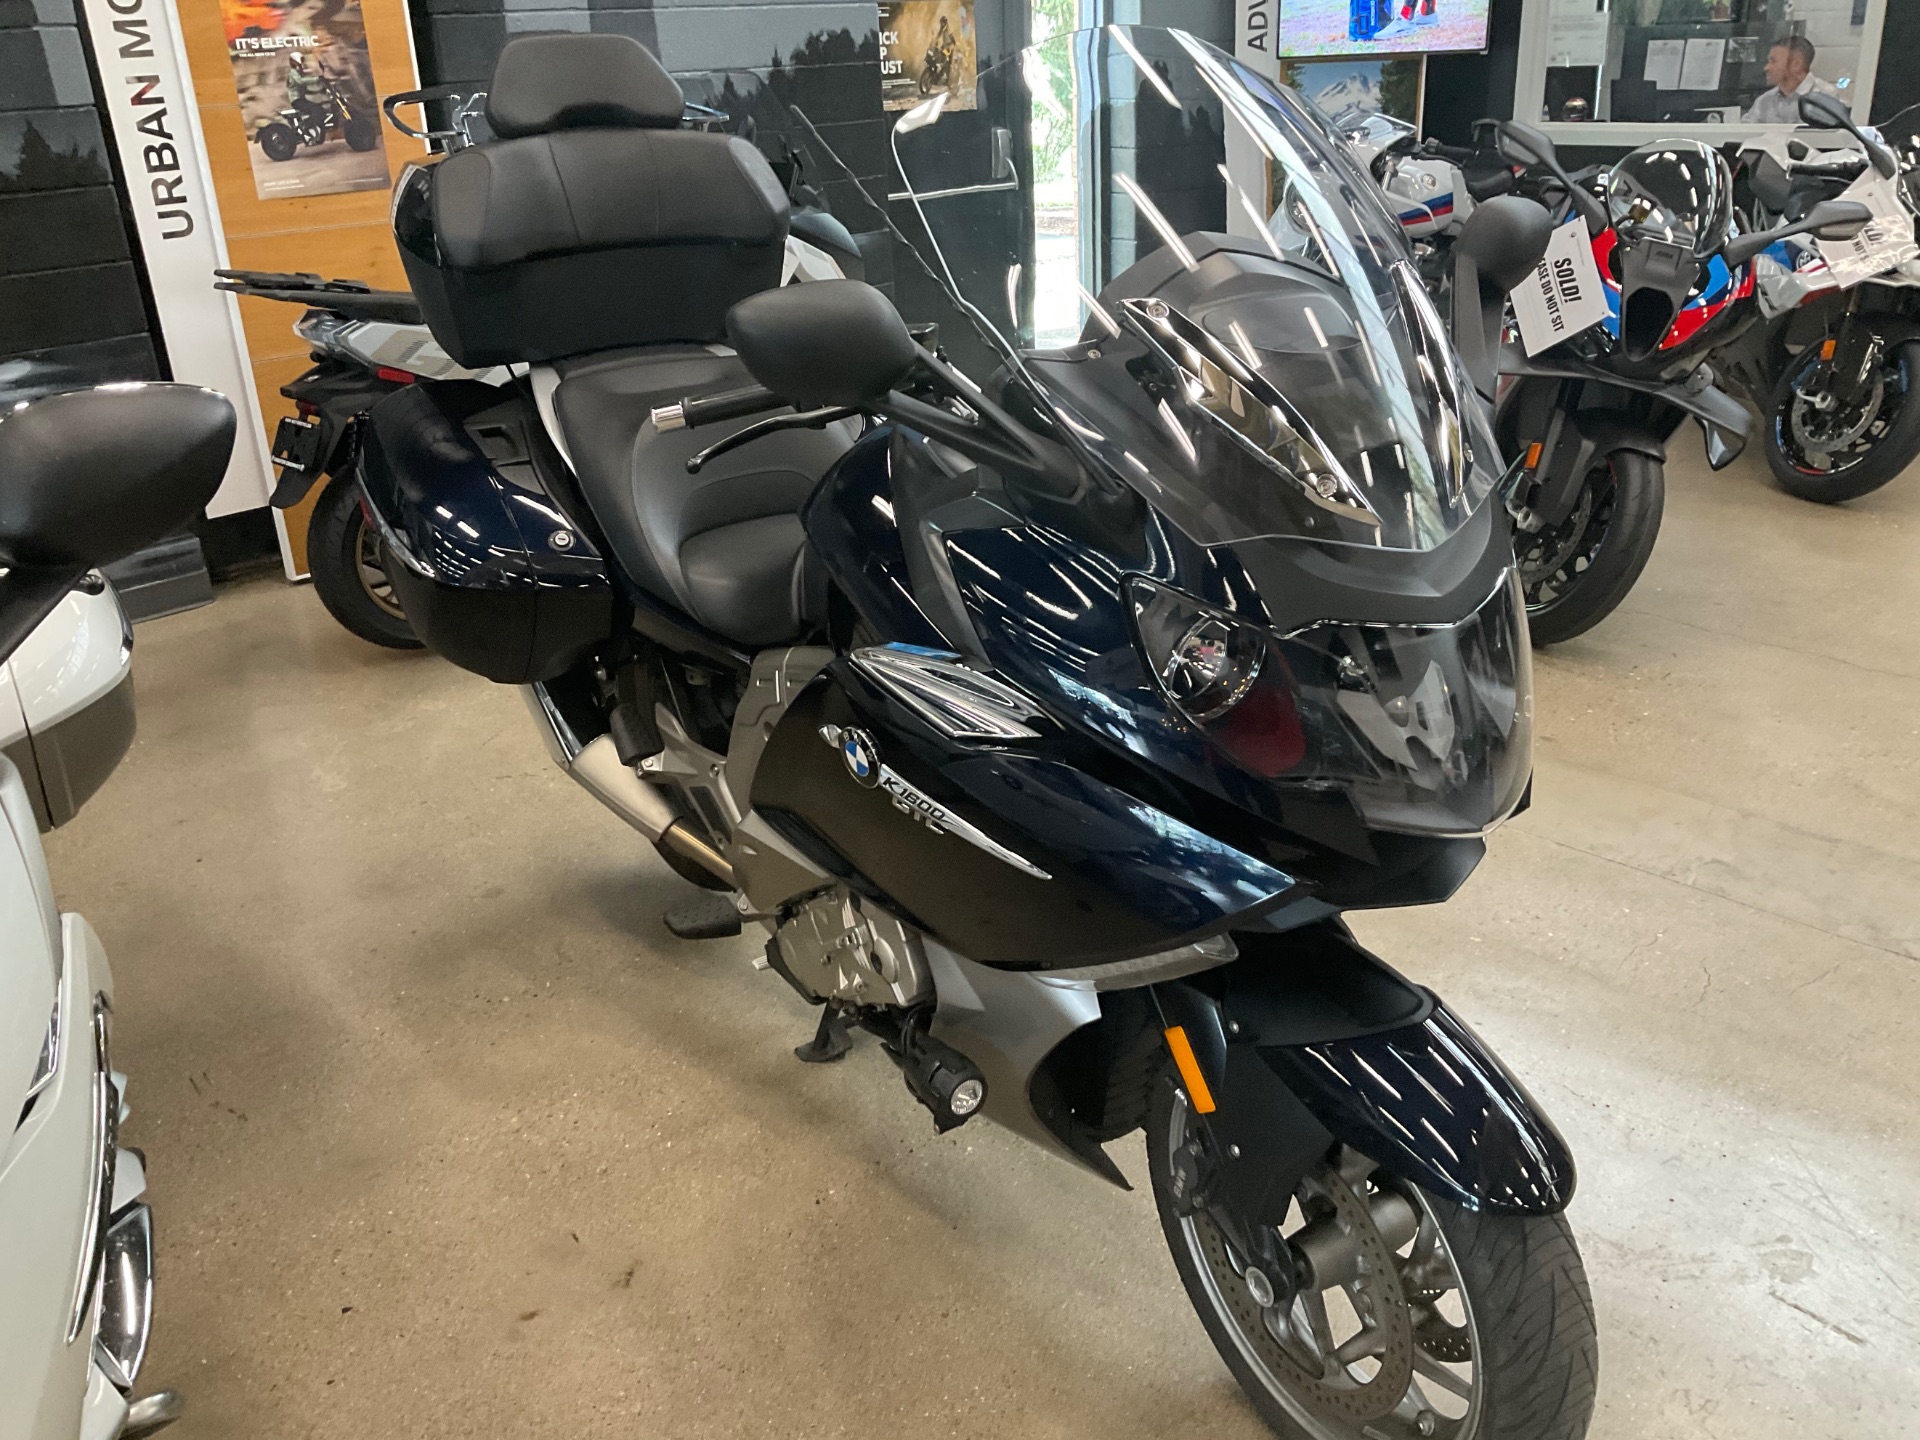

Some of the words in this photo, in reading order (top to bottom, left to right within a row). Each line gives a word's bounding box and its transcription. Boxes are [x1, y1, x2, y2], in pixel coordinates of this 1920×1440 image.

[235, 37, 260, 50] IT'S
[260, 35, 319, 49] ELECTRIC
[125, 75, 194, 240] URBAN
[1541, 279, 1553, 296] DO
[1553, 257, 1583, 303] SOLD!
[1545, 294, 1560, 315] NOT
[1551, 314, 1565, 332] SIT
